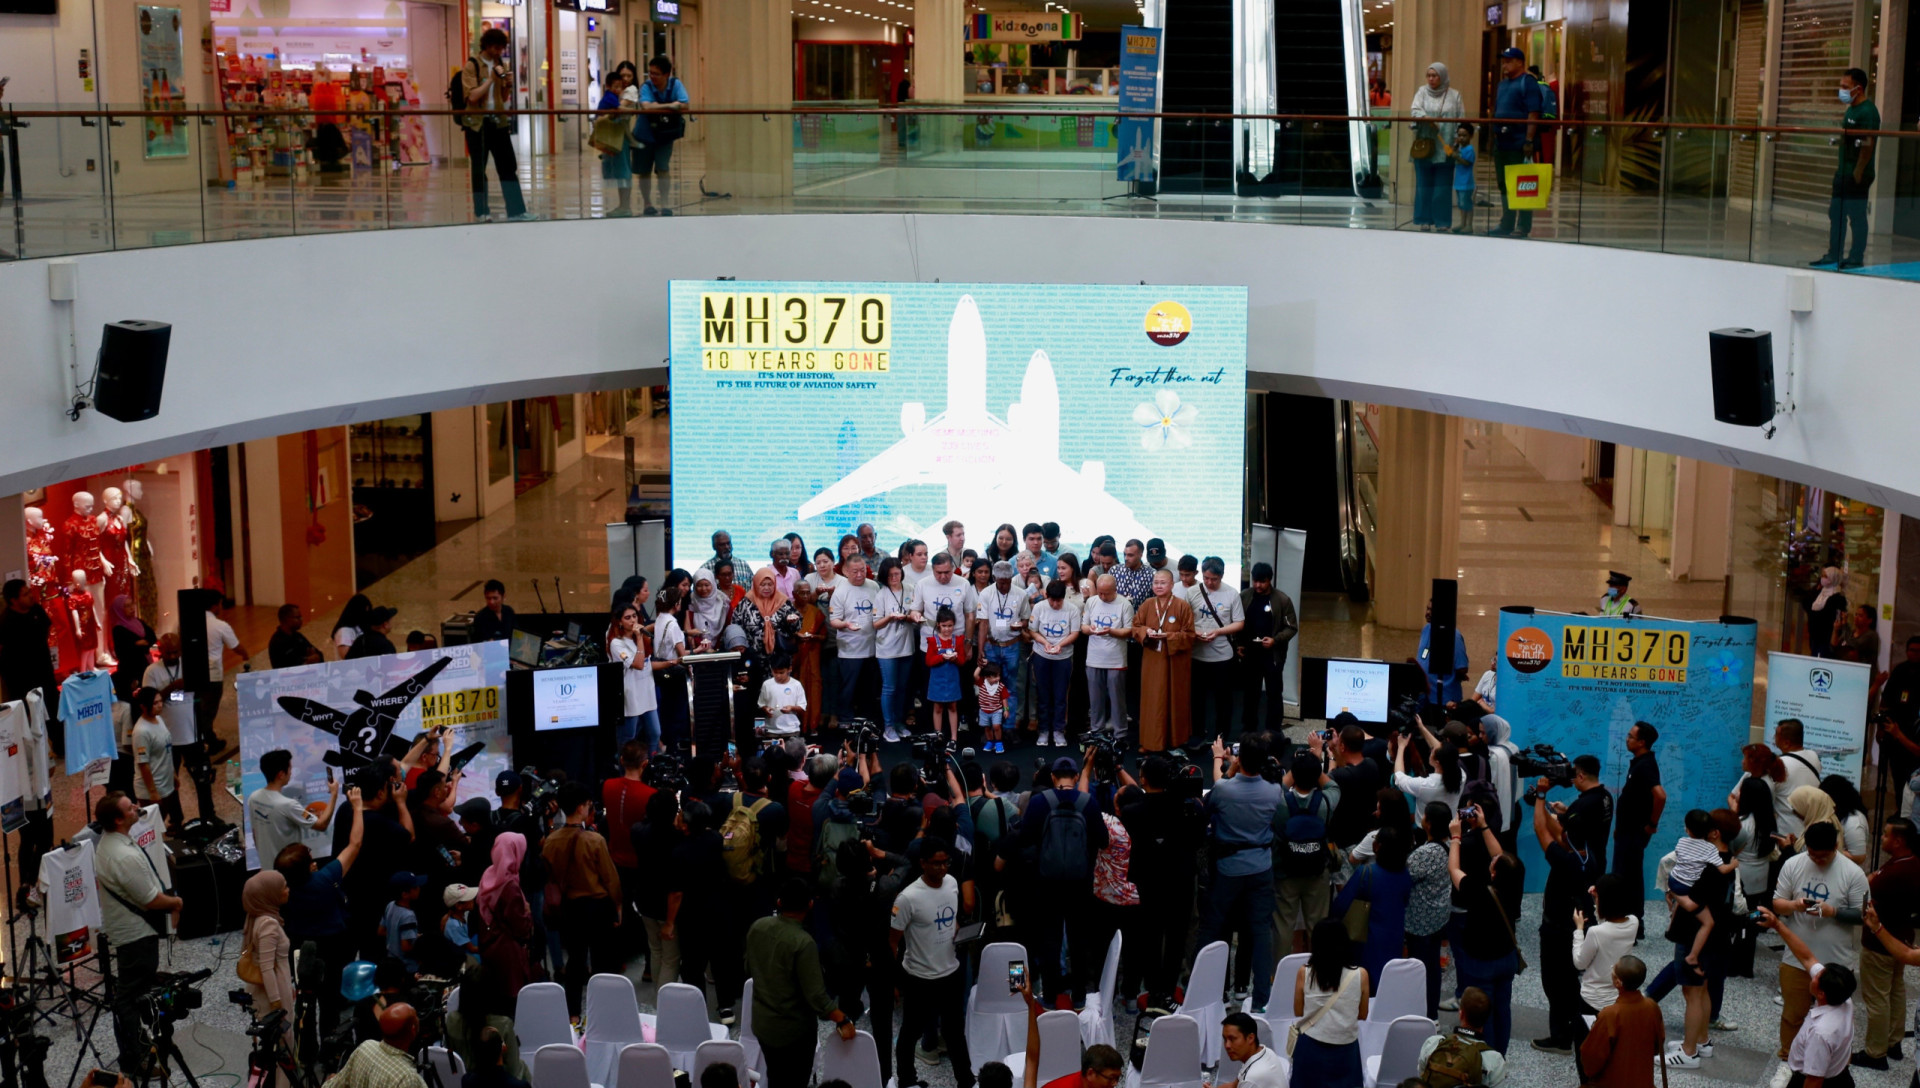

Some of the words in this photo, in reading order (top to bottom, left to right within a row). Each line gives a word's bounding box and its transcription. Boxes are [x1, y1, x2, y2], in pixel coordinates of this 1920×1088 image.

[995, 20, 1058, 34] kidzooona
[1127, 35, 1156, 48] MH370
[1518, 182, 1537, 190] LEGO
[704, 296, 884, 345] MH370
[706, 351, 729, 369] 10
[749, 351, 816, 370] YEARS
[834, 352, 887, 371] GONE
[776, 372, 795, 380] NOT
[796, 372, 836, 381] HISTORY,
[1109, 366, 1161, 388] Forget
[716, 380, 734, 388] IT'S
[754, 381, 788, 389] FUTURE
[803, 382, 844, 390] AVIATION
[845, 382, 877, 390] SAFETY
[440, 645, 473, 657] MH370
[1564, 627, 1686, 665] MH370
[1564, 666, 1580, 676] 10
[1593, 667, 1637, 680] YEARS
[1649, 669, 1686, 682] GONE
[560, 683, 572, 696] 10
[1352, 677, 1364, 689] 10
[370, 695, 409, 708] WHERE?
[422, 688, 496, 718] MH370
[77, 702, 103, 720] MH370
[311, 712, 334, 723] WHY?
[441, 715, 469, 726] YEARS
[476, 710, 499, 722] GONE
[345, 766, 360, 777] HO
